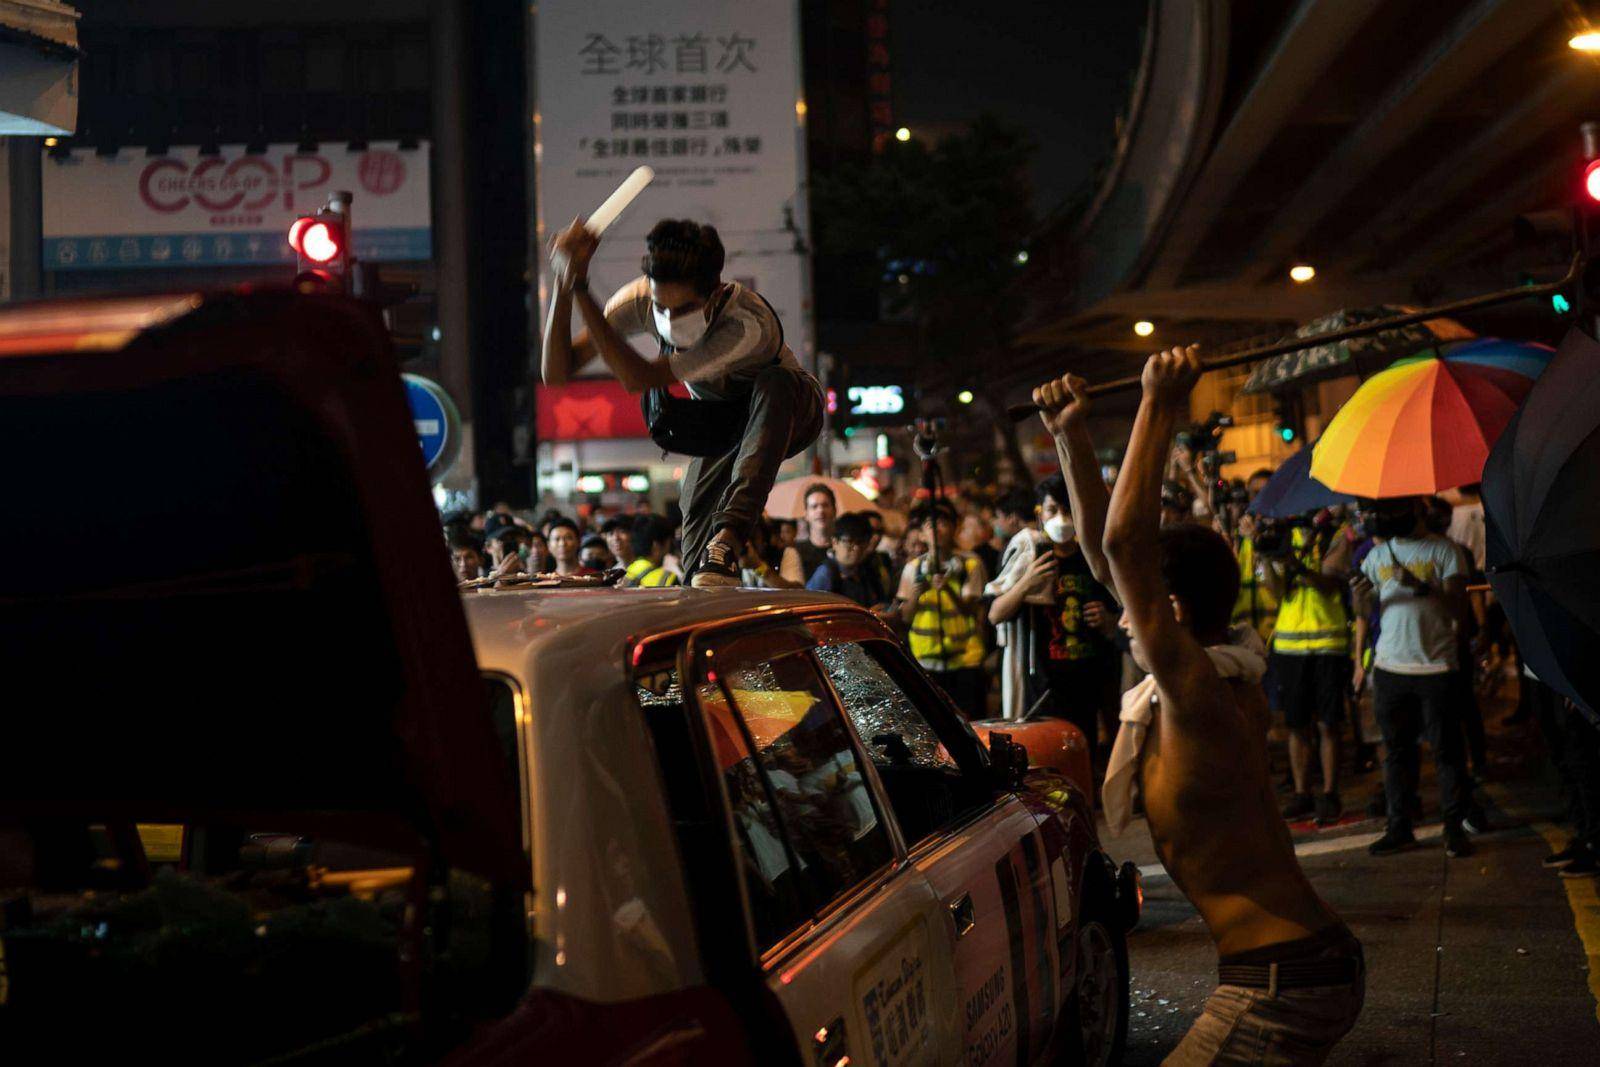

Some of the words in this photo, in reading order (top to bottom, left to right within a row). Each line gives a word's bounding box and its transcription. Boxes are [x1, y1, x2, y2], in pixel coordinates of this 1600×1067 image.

[578, 32, 758, 75] 全球首次
[965, 964, 1005, 1032] SAMSUNG
